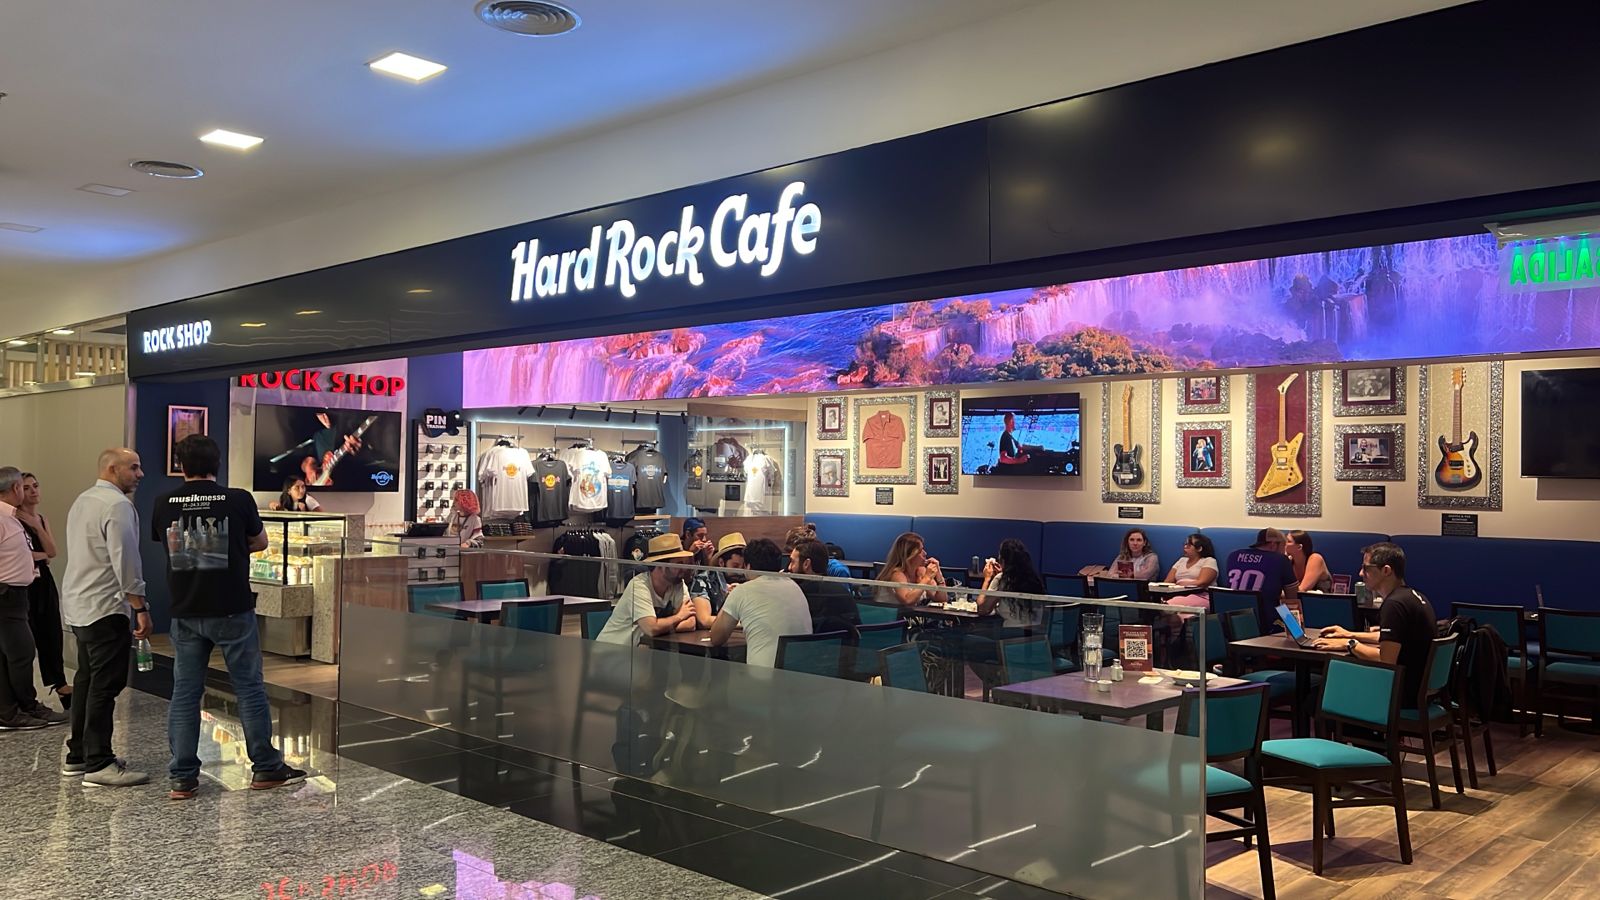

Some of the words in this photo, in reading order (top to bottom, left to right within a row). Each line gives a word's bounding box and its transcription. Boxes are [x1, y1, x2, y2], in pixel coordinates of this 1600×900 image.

[511, 225, 602, 302] Hard
[604, 205, 704, 298] Rock
[710, 181, 822, 277] Cafe
[143, 327, 175, 353] ROCK
[177, 320, 212, 349] SHOP
[331, 372, 405, 396] SHOP
[426, 415, 447, 425] PIN
[168, 494, 226, 503] musikmesse
[1237, 553, 1263, 563] MESSI
[1228, 568, 1265, 592] 30
